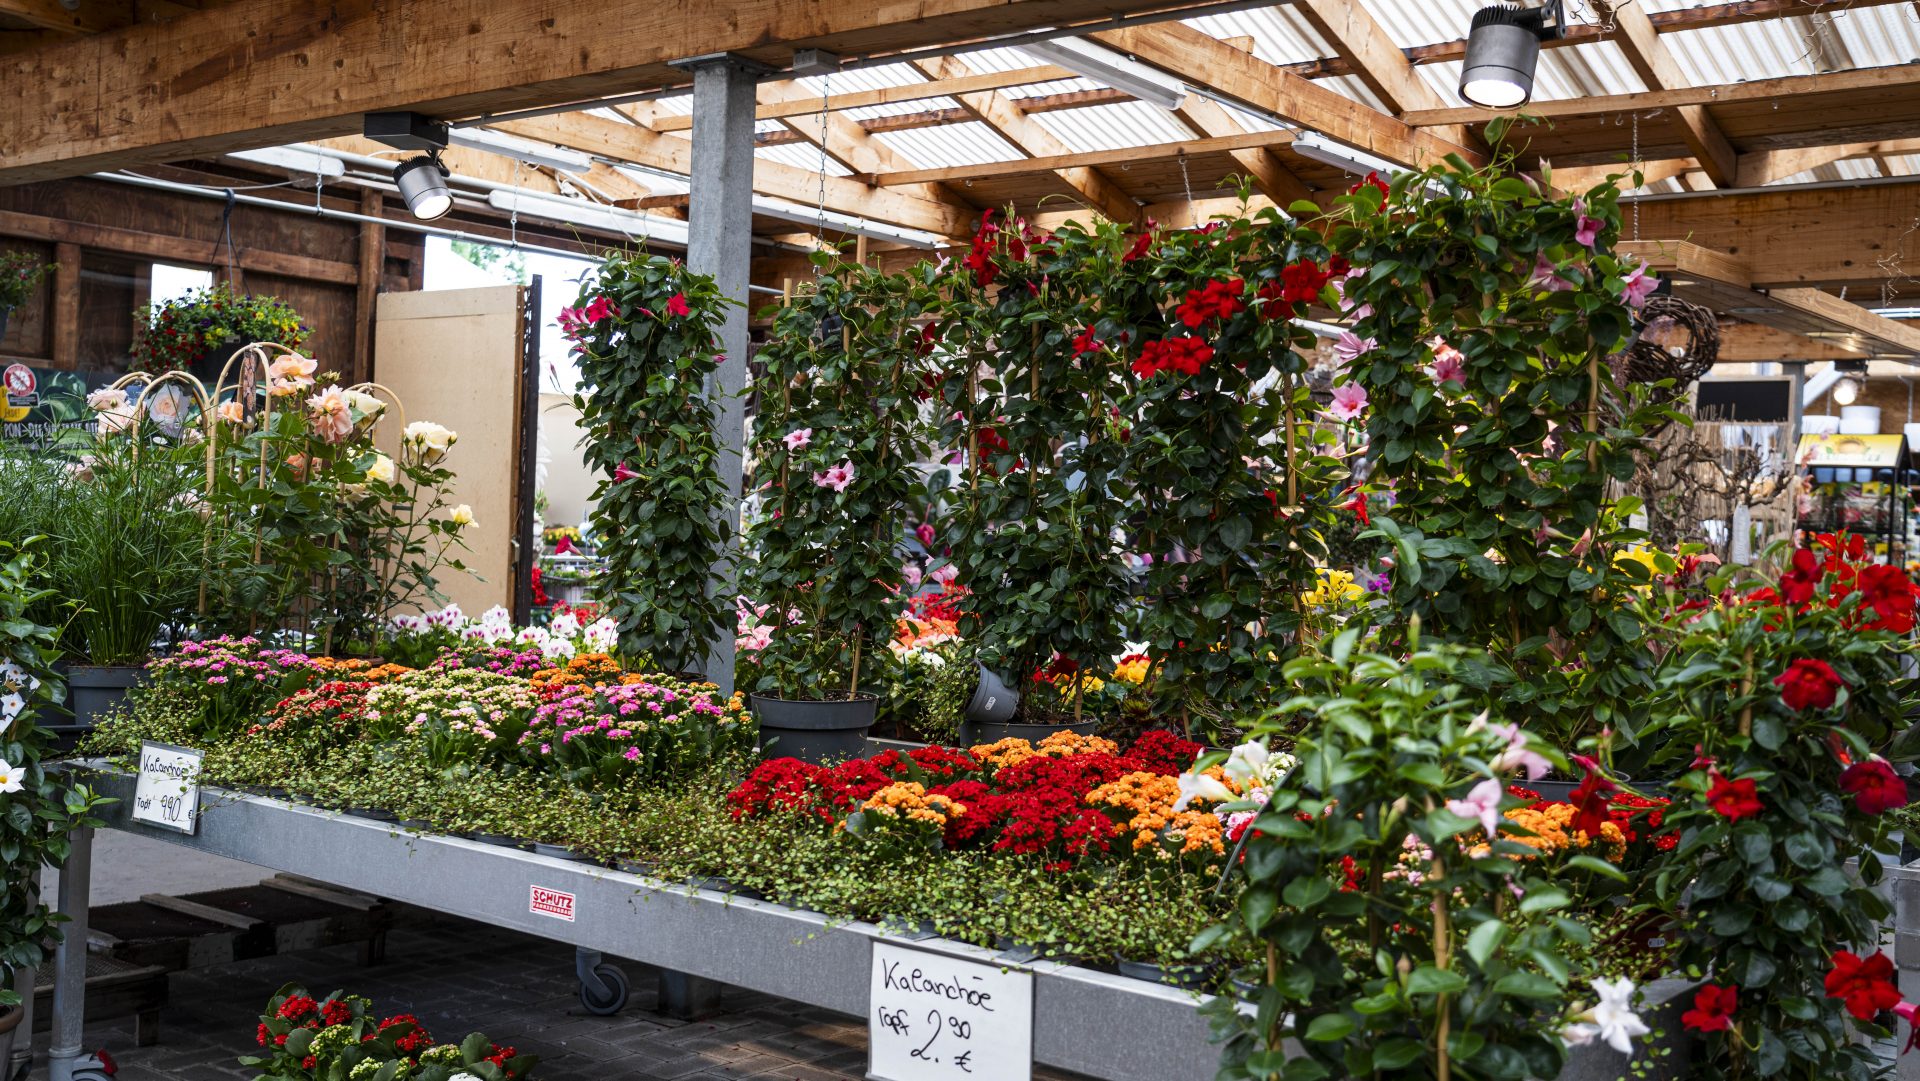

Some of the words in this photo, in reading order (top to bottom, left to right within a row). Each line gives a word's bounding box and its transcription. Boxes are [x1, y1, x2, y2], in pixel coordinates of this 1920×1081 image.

[137, 797, 151, 811] Topf
[188, 809, 193, 820] €
[533, 890, 573, 909] SCHUTZ
[878, 1006, 910, 1036] Topf
[954, 1050, 973, 1073] €
